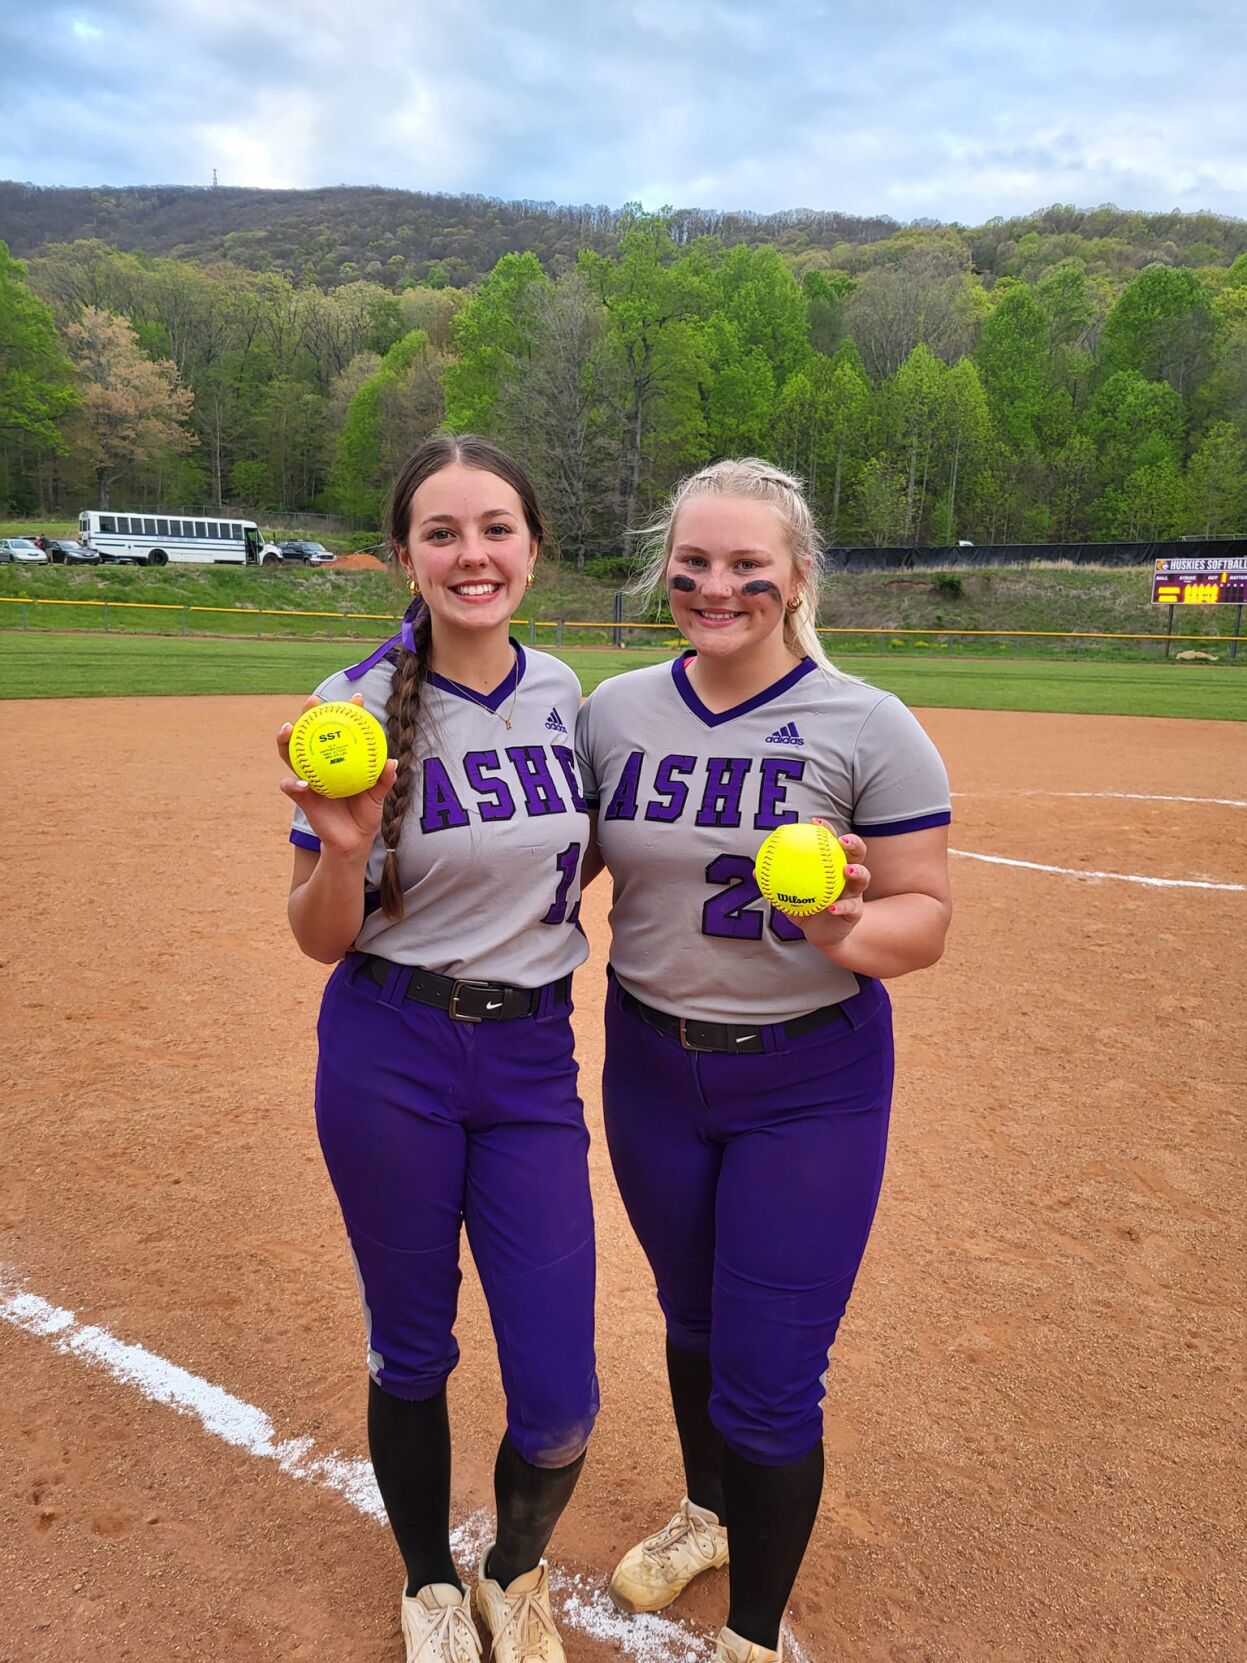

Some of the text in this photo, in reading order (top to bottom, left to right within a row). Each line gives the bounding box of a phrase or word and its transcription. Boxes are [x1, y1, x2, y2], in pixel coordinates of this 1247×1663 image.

[1170, 560, 1247, 570] HUSKIES SOFTBALL
[319, 731, 342, 743] SST
[765, 735, 804, 746] adidas
[604, 751, 806, 830] ASHE
[540, 842, 581, 924] 1
[702, 853, 806, 941] 2
[777, 893, 816, 904] Wilson
